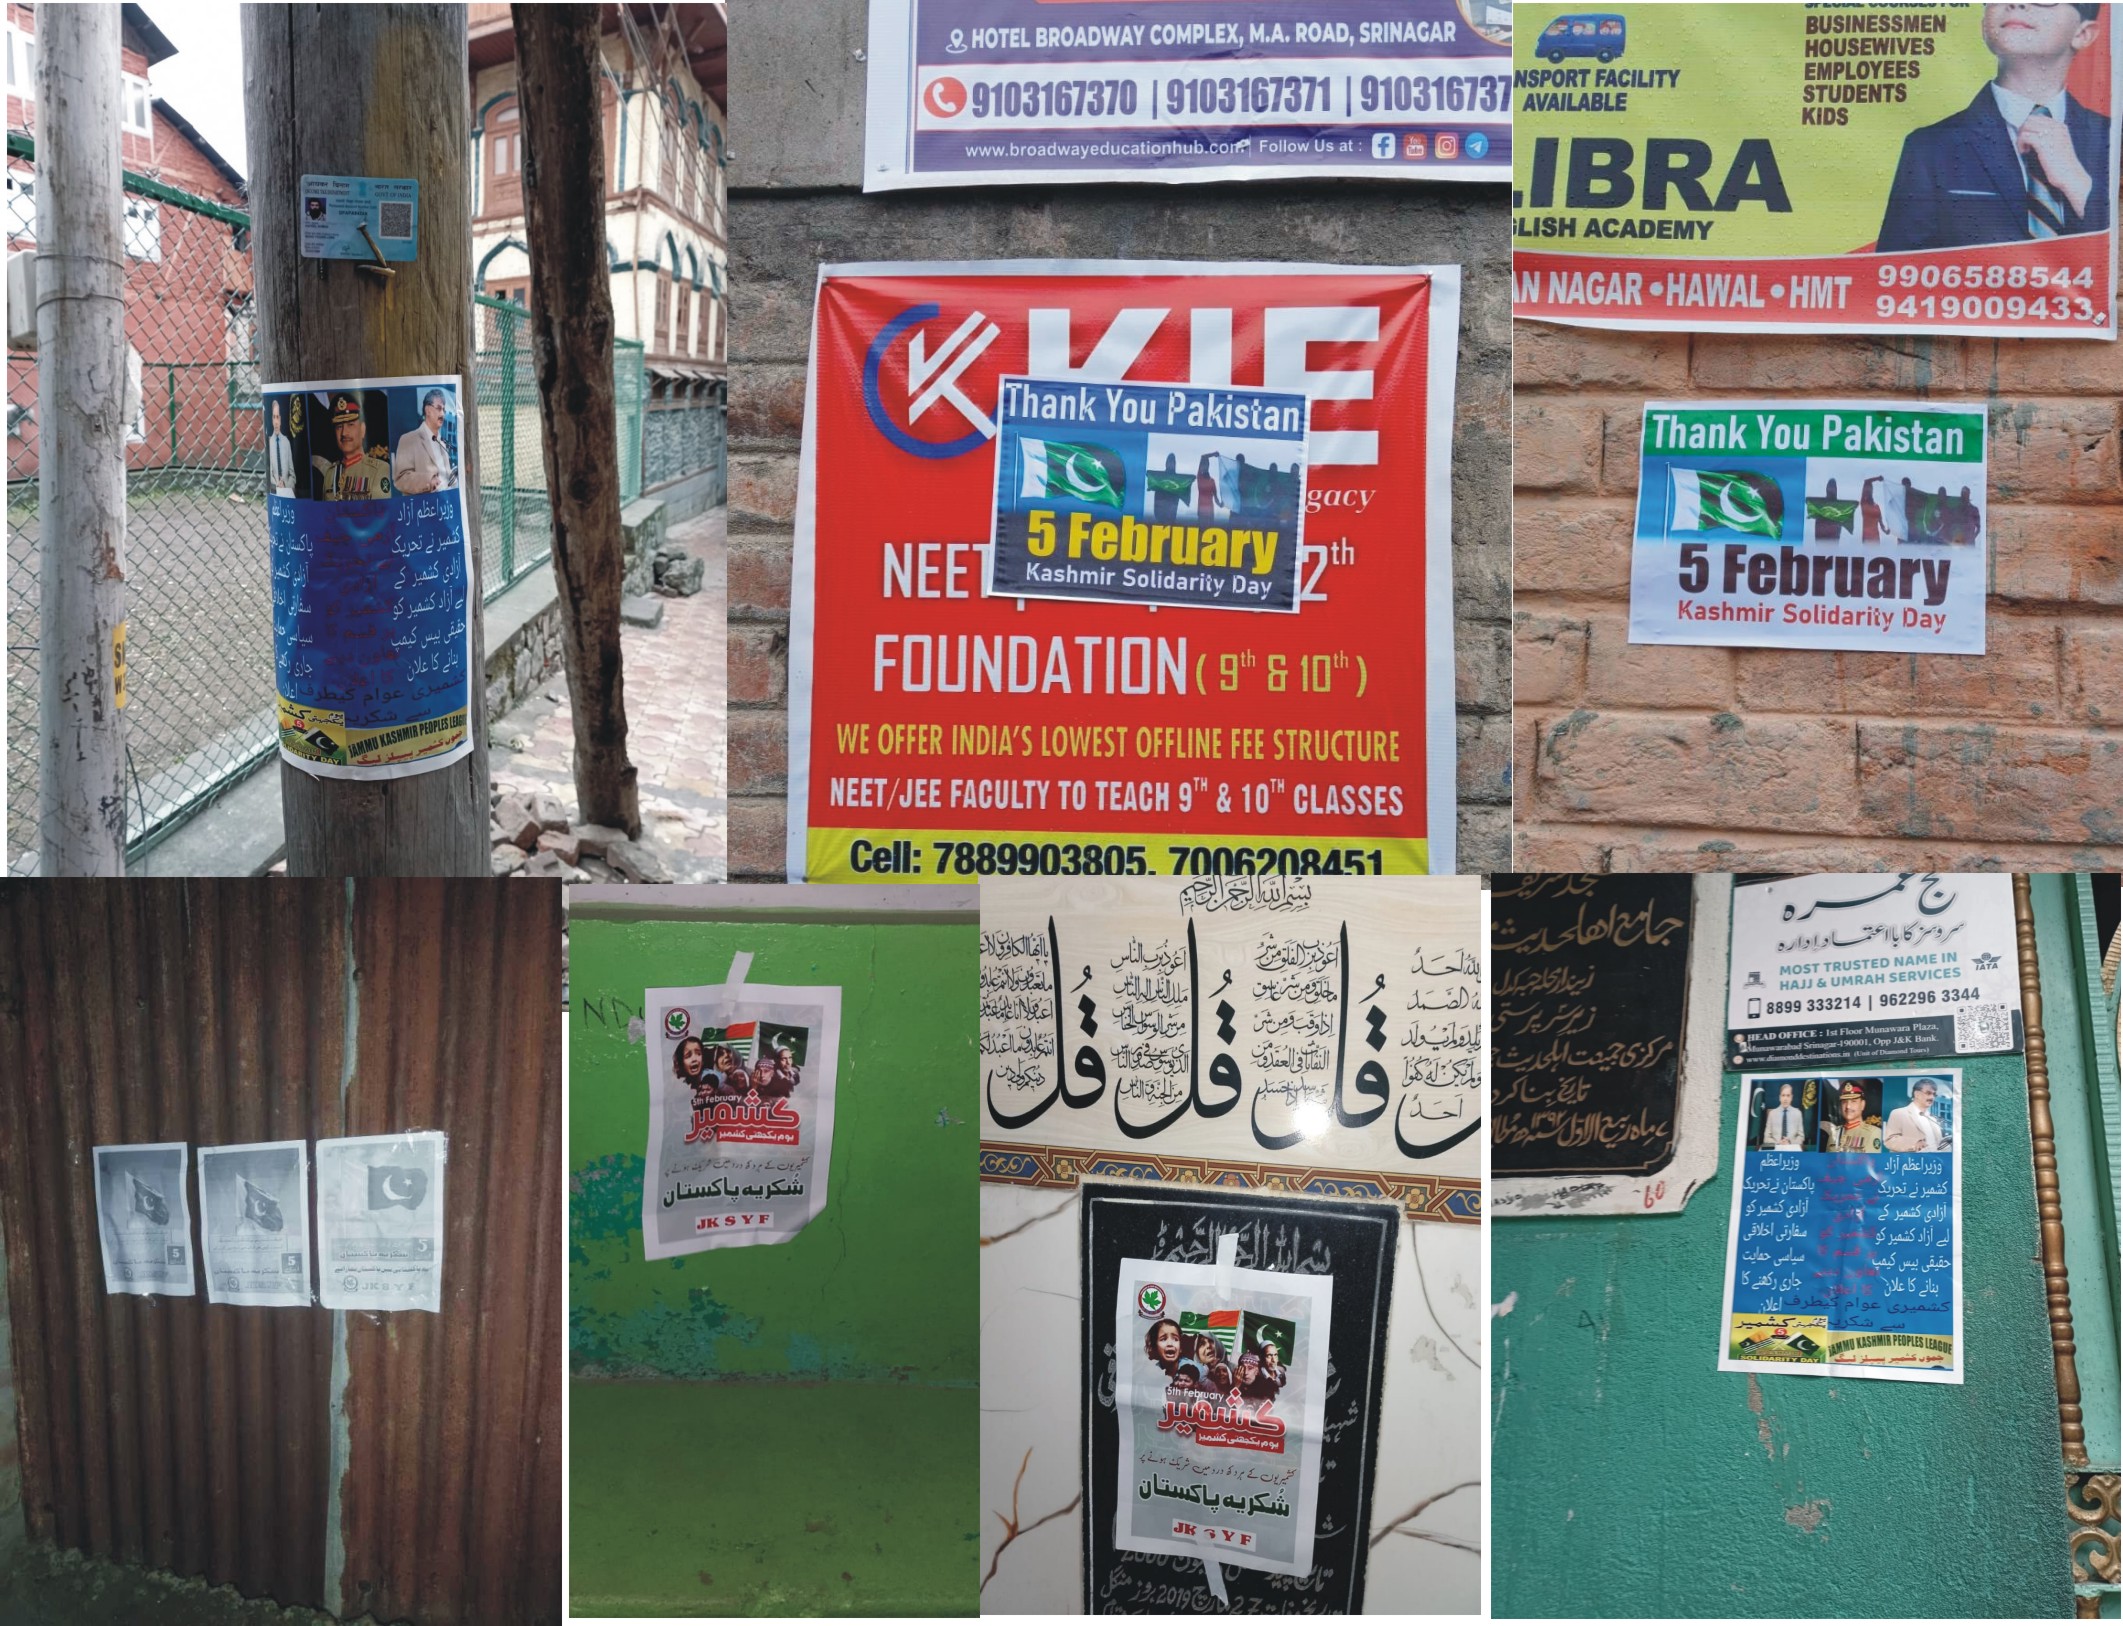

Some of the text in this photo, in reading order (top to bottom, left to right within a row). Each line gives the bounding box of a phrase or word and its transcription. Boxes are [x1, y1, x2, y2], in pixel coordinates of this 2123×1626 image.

[971, 21, 1456, 49] HOTEL BROADWAY COMPLEX, M.A. ROAD, SRINAGAR
[1805, 15, 1947, 34] BUSINESSMEN
[1805, 37, 1936, 58] HOUSEWIVES
[1595, 69, 1681, 88] FACILITY
[1804, 60, 1921, 81] EMPLOYEES
[972, 79, 1138, 118] 9103167370
[1166, 76, 1331, 115] 9103167371
[1522, 92, 1628, 112] AVAILABLE
[1803, 83, 1908, 104] STUDENTS
[1801, 107, 1849, 126] KIDS
[1259, 138, 1354, 153] Follow Us at
[1513, 137, 1793, 213] IBRA
[1583, 218, 1715, 240] ACADEMY
[1878, 264, 2094, 289] 9906588544
[1547, 271, 1643, 306] NAGAR
[1789, 275, 1852, 310] HMT
[1876, 294, 2093, 321] 9419009433
[1005, 382, 1299, 433] Thank You Pakistan
[1652, 413, 1964, 456] Thank You Pakistan
[1027, 510, 1279, 575] 5 February
[1026, 561, 1273, 600] Kashmir Solidarity Day
[1678, 542, 1951, 606] 5 February
[1677, 599, 1947, 635] Kashmir Solidarity Day
[873, 633, 1350, 695] FOUNDATION 9th & 10th
[379, 726, 418, 747] KASHMIR
[419, 717, 449, 736] PEOPLES
[837, 723, 870, 755] WE
[877, 723, 943, 755] OFFER
[1041, 725, 1128, 758] LOWEST
[1135, 726, 1222, 759] OFFLINE
[1231, 727, 1265, 760] FEE
[1272, 728, 1400, 763] STRUCTURE
[320, 756, 339, 765] DAY
[830, 776, 1404, 817] NEET/JEE FACULTY TO TEACH 9TH & 10TH CLASSES
[850, 839, 922, 875] Cell:
[1168, 845, 1383, 876] 7006208451
[1779, 951, 1958, 976] MOST TRUSTED NAME IN
[1975, 962, 1999, 971] IATA
[1779, 967, 1962, 991] HAJJ & UMRAH SERVICES
[1766, 986, 1981, 1015] 8899 333214 962296 3344
[1747, 1022, 1940, 1042] HEAD OFFICE 1st Floor Munawara Plaza,
[1873, 1037, 1892, 1047] Opp
[1892, 1035, 1912, 1044] J&K
[1879, 1047, 1908, 1056] Diamond
[706, 1094, 742, 1103] February
[684, 1089, 801, 1143] کشمیر
[1921, 1180, 1949, 1199] کشمیر
[1758, 1199, 1784, 1217] کشمیر
[1894, 1204, 1922, 1222] کشمیر
[724, 1216, 736, 1226] S
[741, 1215, 754, 1225] Y
[759, 1214, 770, 1224] F
[172, 1249, 180, 1258] 5
[418, 1239, 428, 1252] 5
[287, 1256, 296, 1266] 5
[1734, 1316, 1797, 1329] کشمیر
[1856, 1334, 1892, 1348] KASHMIR
[1893, 1334, 1924, 1347] PEOPLES
[1925, 1337, 1952, 1355] LEAGUE
[1167, 1387, 1225, 1402] 5th February
[1157, 1387, 1286, 1437] کشمیر
[1173, 1522, 1197, 1536] JK
[1222, 1529, 1234, 1541] Y
[1239, 1534, 1252, 1546] F
